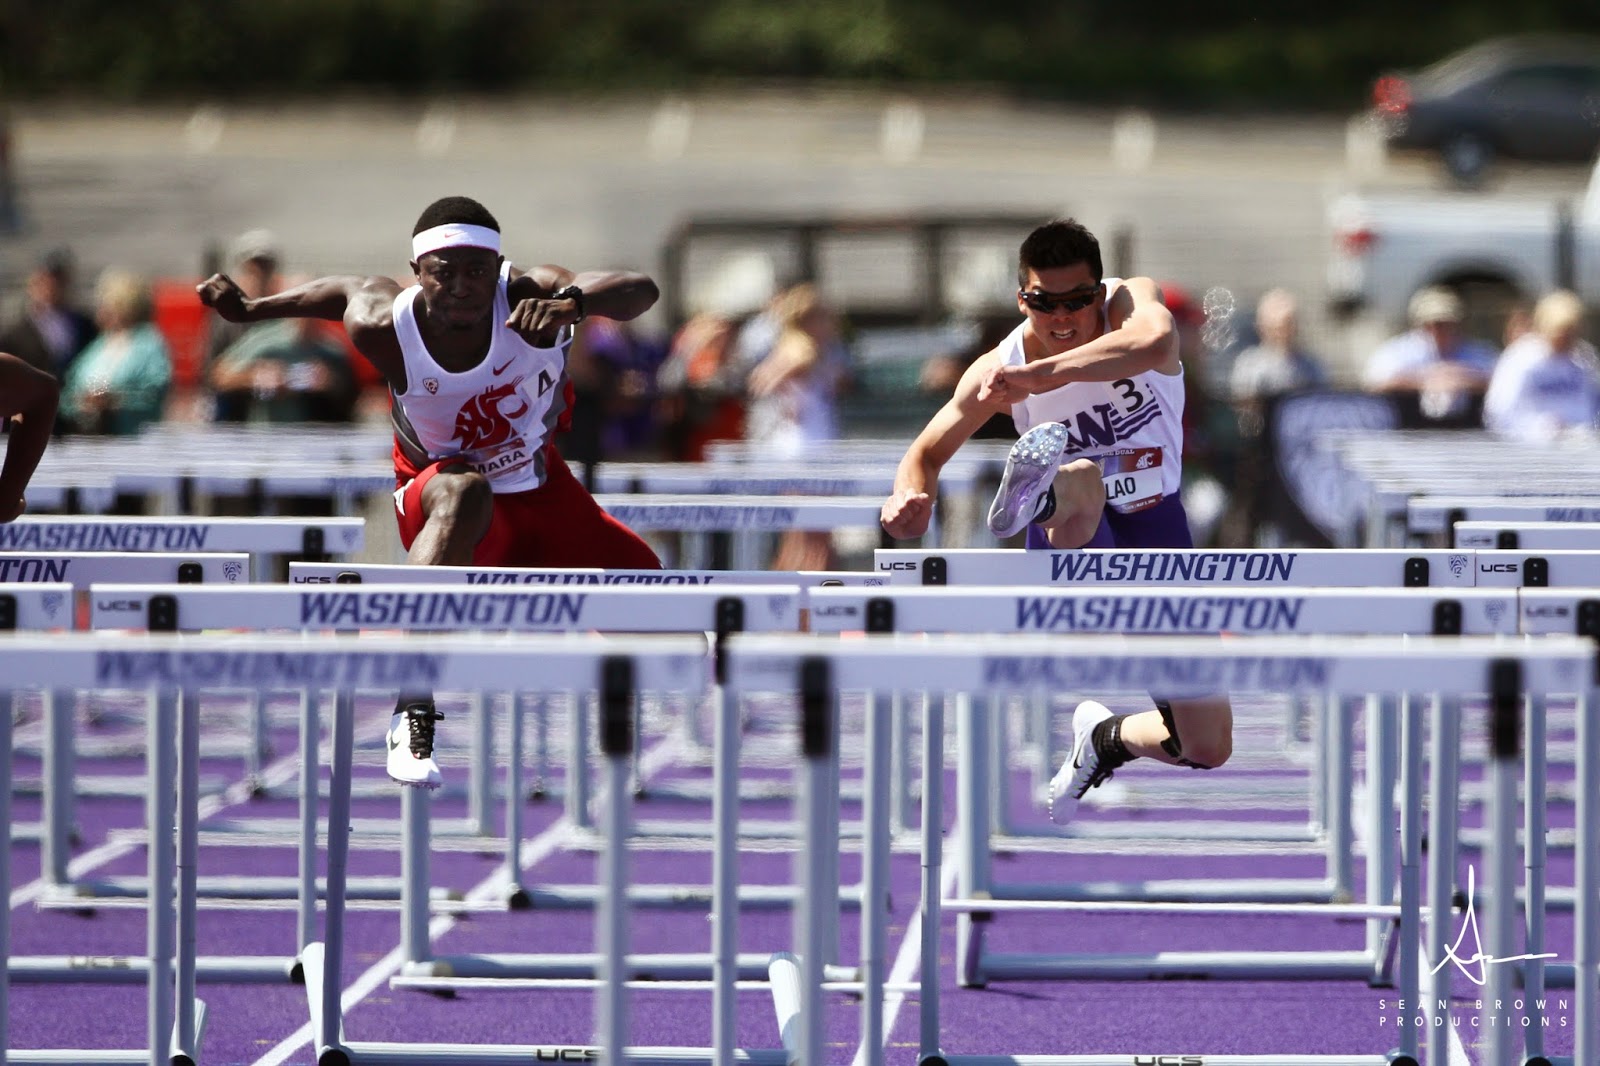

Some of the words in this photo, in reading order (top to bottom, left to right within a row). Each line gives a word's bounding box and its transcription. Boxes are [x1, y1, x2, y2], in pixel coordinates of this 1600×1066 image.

[538, 369, 556, 398] 4
[1112, 378, 1143, 413] 3
[1060, 402, 1117, 449] W
[1105, 477, 1136, 500] LAO
[0, 524, 208, 549] WASHINGTON
[880, 562, 917, 571] UCS
[1050, 553, 1297, 581] WASHINGTON
[1481, 564, 1518, 573] UCS
[294, 576, 332, 584] UCS
[97, 599, 142, 612] UCS
[300, 592, 587, 624] WASHINGTON
[1015, 598, 1304, 630] WASHINGTON
[536, 1049, 600, 1062] UCS
[1134, 1056, 1204, 1066] UCS
